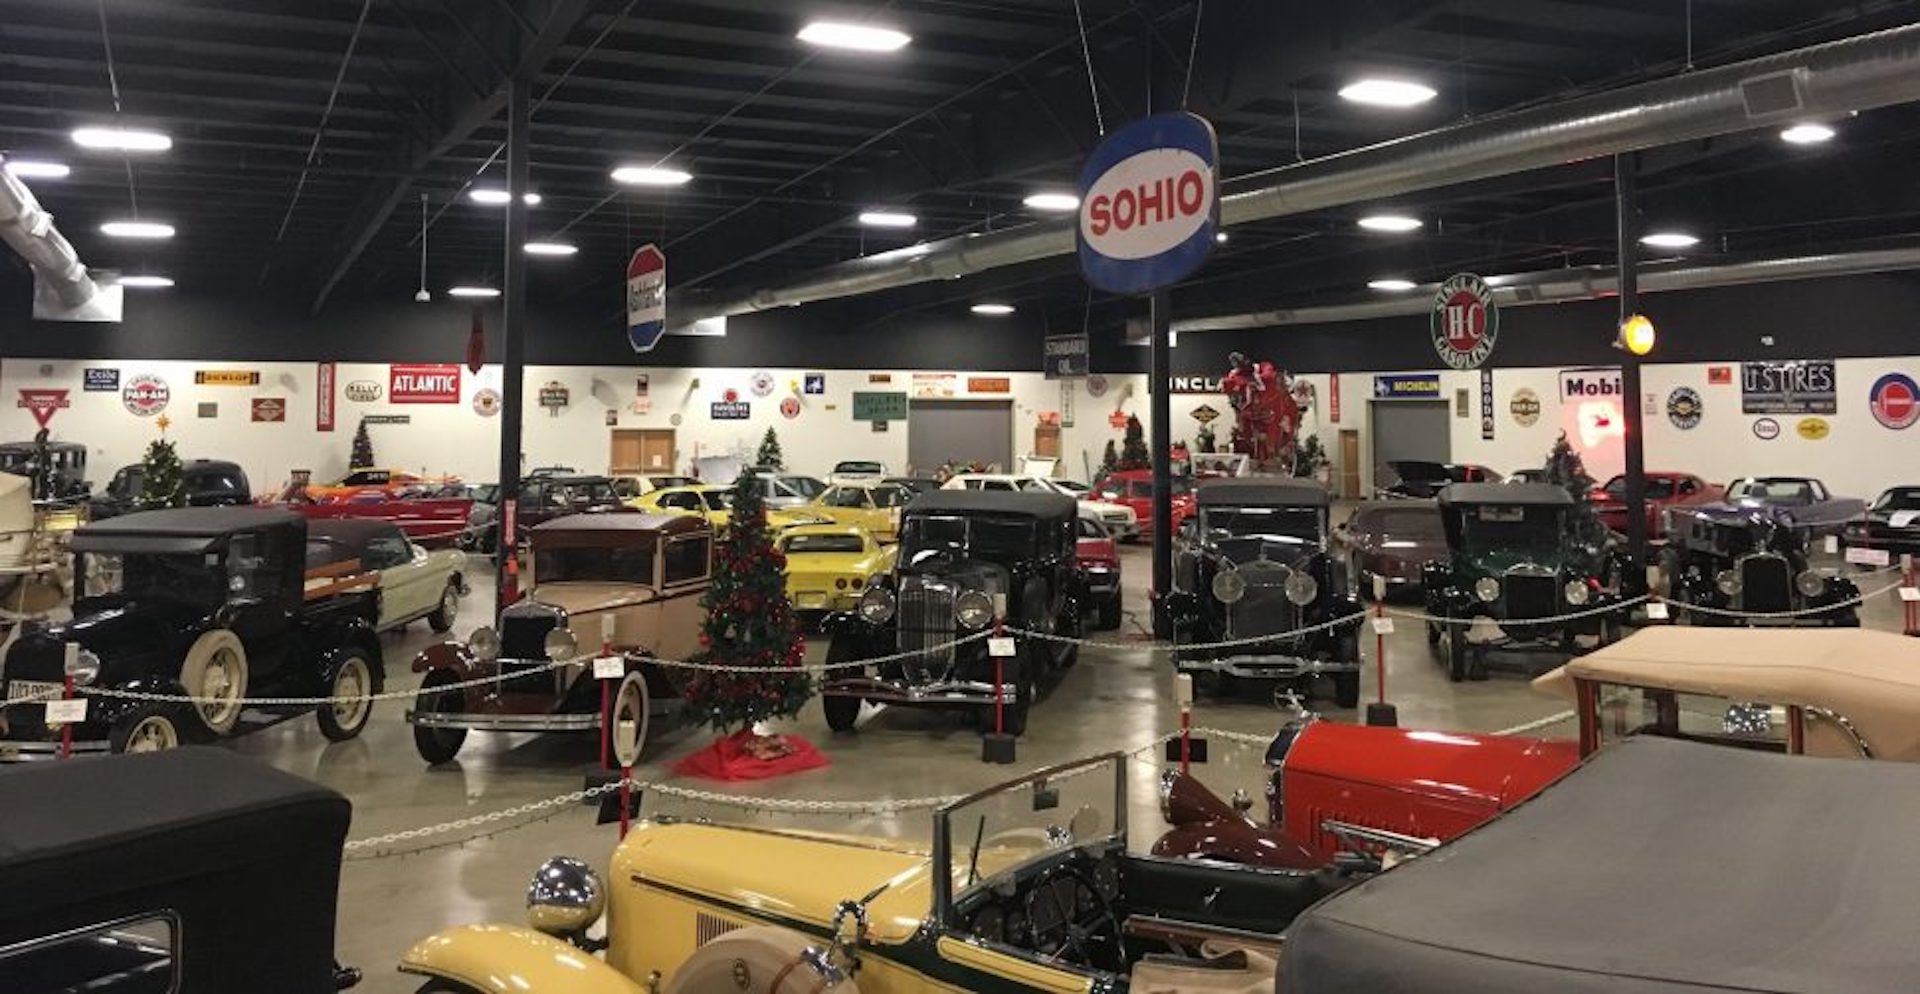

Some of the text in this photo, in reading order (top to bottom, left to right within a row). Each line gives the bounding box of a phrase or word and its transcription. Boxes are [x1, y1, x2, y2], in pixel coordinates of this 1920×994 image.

[1089, 169, 1204, 237] SOHIO
[1435, 276, 1491, 312] SINCLAIR
[1046, 339, 1086, 355] STANDARD
[1436, 335, 1495, 368] GASOLINE
[89, 369, 117, 379] Exide
[1058, 359, 1072, 374] OIL
[206, 373, 249, 381] DUNLOP
[392, 375, 457, 392] ATLANTIC
[350, 385, 378, 394] KELLY
[1393, 381, 1439, 392] MICHELIN
[1566, 377, 1622, 396] Mobi
[126, 388, 168, 401] PAN-AM
